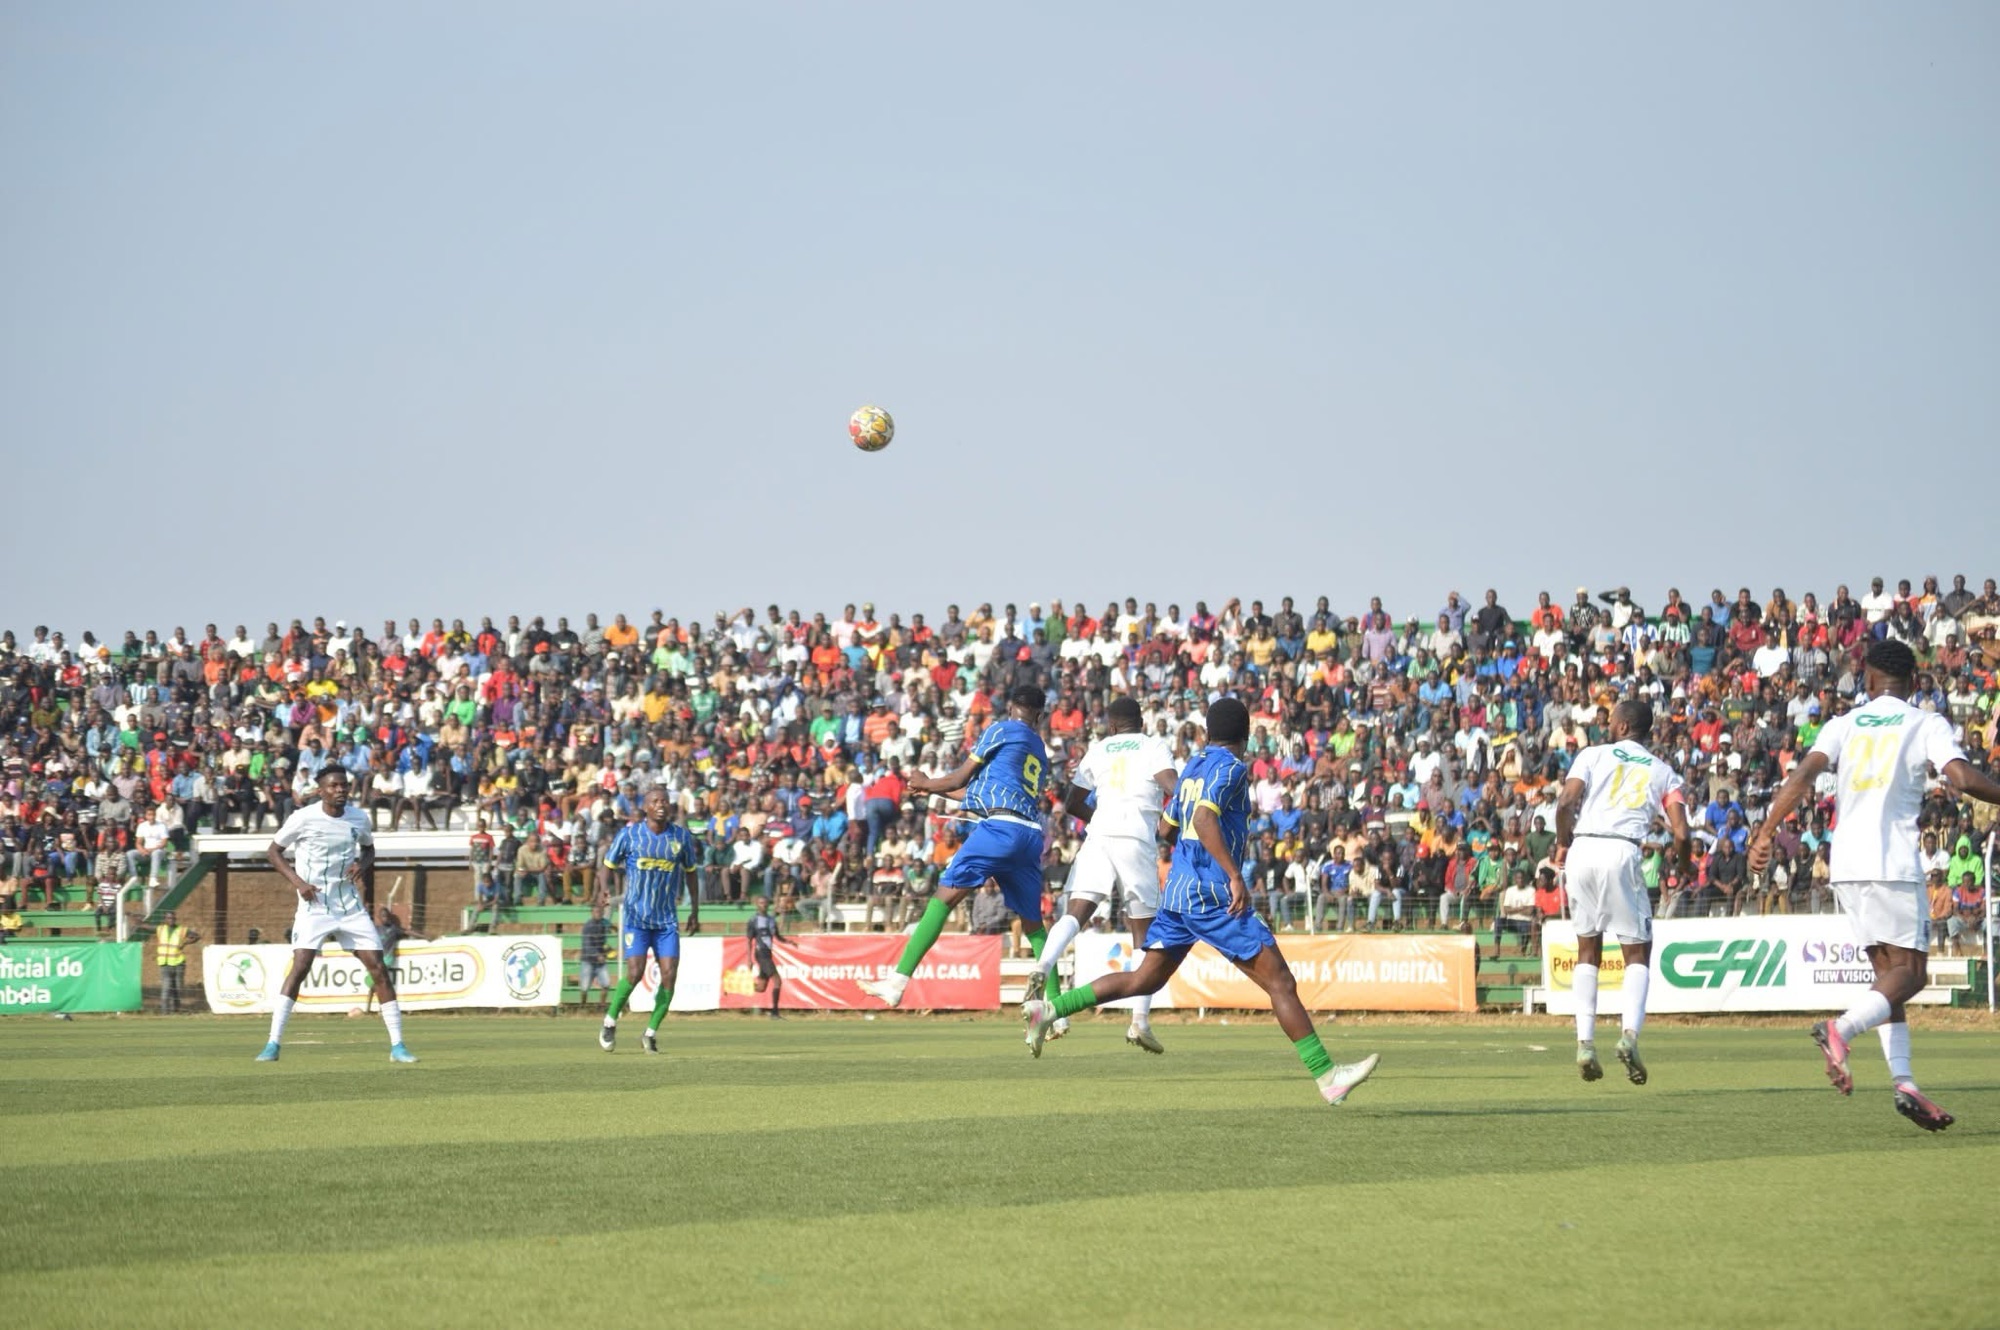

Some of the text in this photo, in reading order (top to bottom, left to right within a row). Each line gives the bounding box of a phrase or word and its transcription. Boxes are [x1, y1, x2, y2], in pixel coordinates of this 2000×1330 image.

[1022, 754, 1042, 799] 9
[1608, 763, 1649, 810] 13
[56, 955, 83, 977] do
[303, 958, 464, 993] Moçmbola
[812, 965, 875, 980] DIGITAL
[914, 964, 935, 980] UA
[937, 964, 981, 980] CASA
[1289, 960, 1316, 983] OM
[1319, 961, 1333, 983] A
[1335, 960, 1376, 983] VIDA
[1379, 960, 1448, 983] DIGITAL
[1815, 970, 1840, 982] NEW
